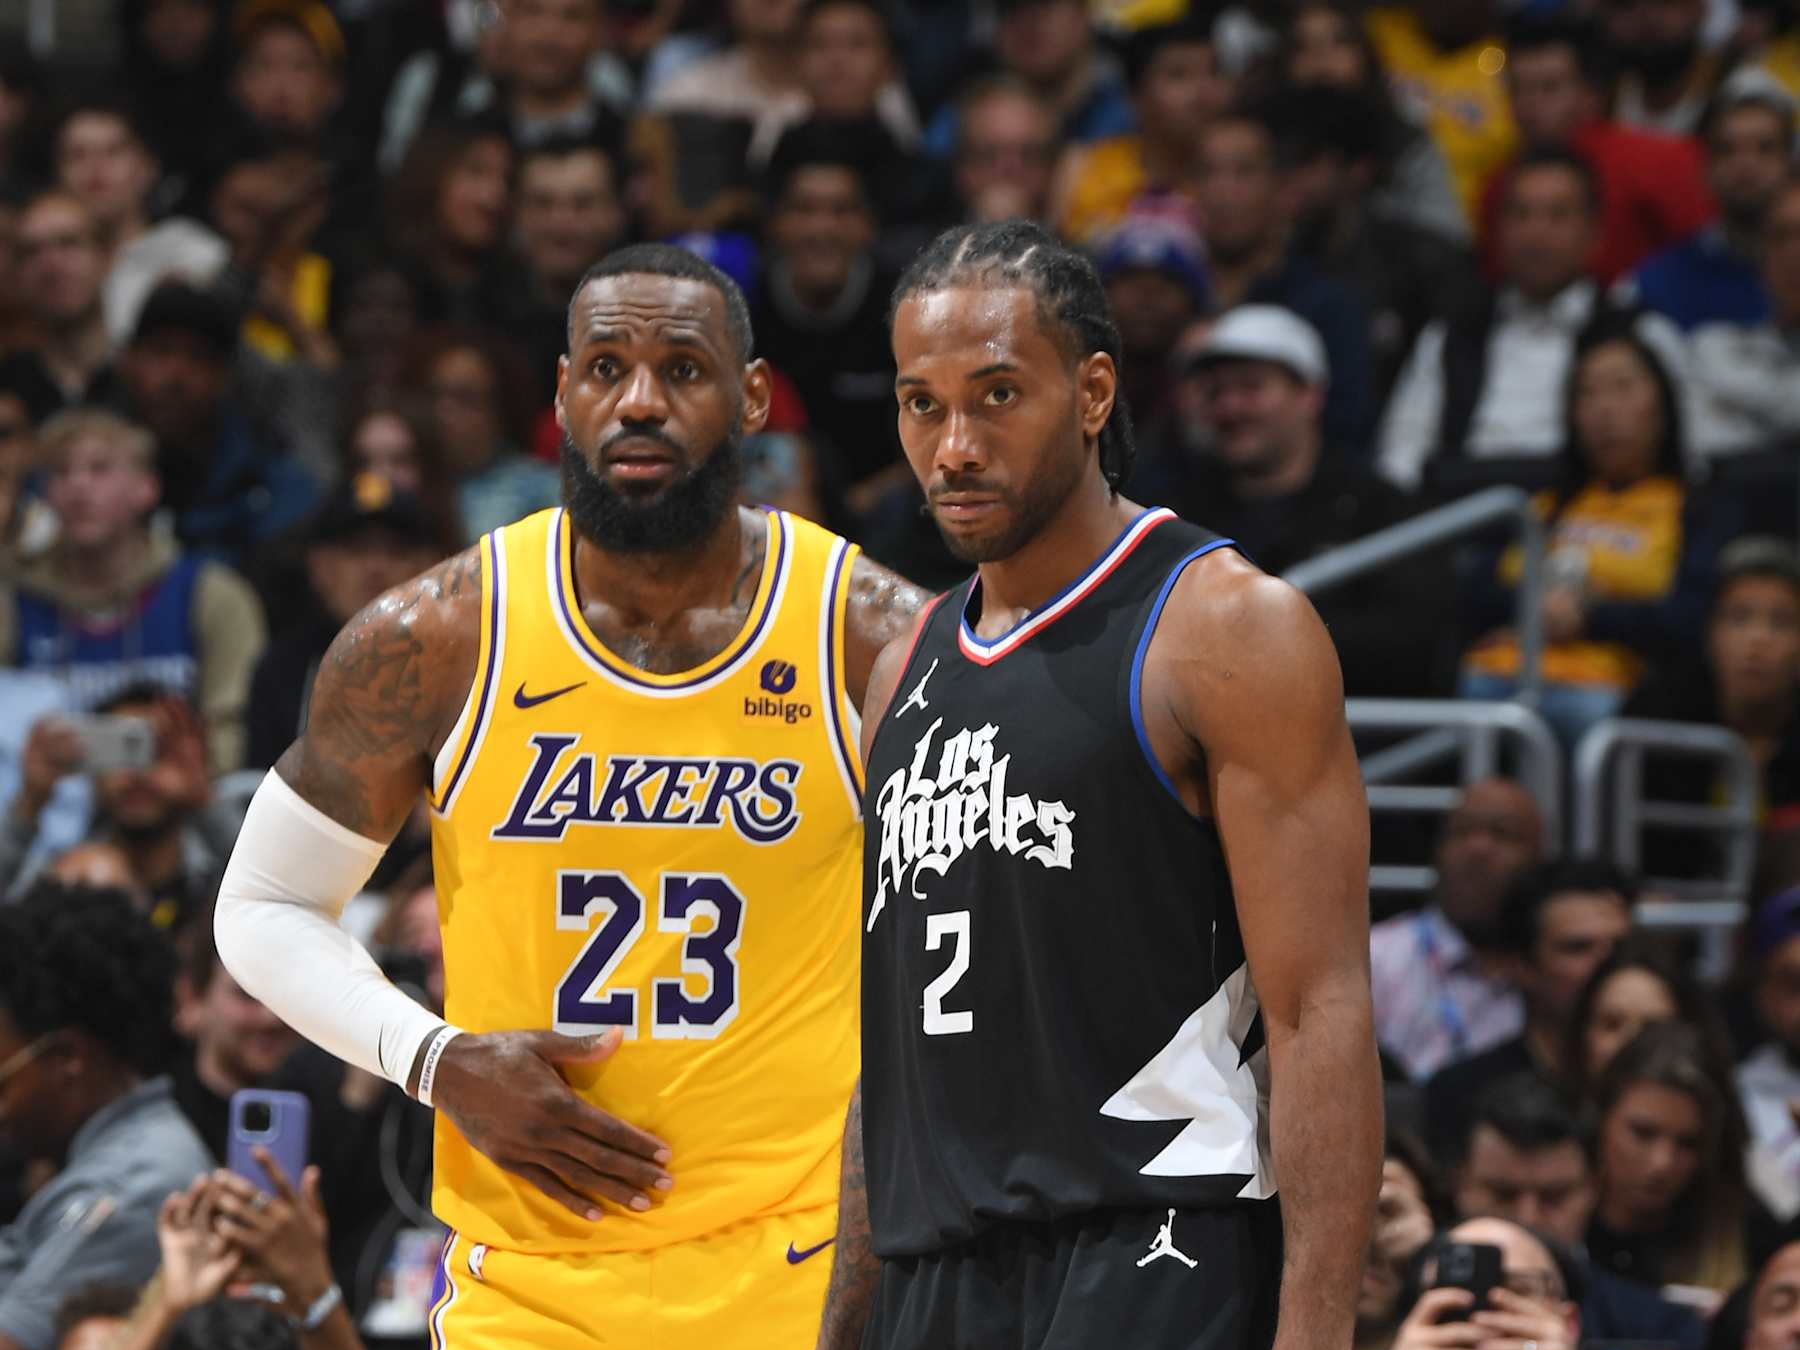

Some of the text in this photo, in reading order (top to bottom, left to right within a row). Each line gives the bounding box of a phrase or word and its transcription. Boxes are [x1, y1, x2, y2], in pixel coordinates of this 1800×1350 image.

[744, 698, 811, 724] bibigo
[903, 717, 1000, 798] Los
[489, 733, 804, 846] LAKERS
[866, 754, 1076, 932] Angeles
[552, 869, 747, 1040] 23
[923, 910, 974, 1035] 2
